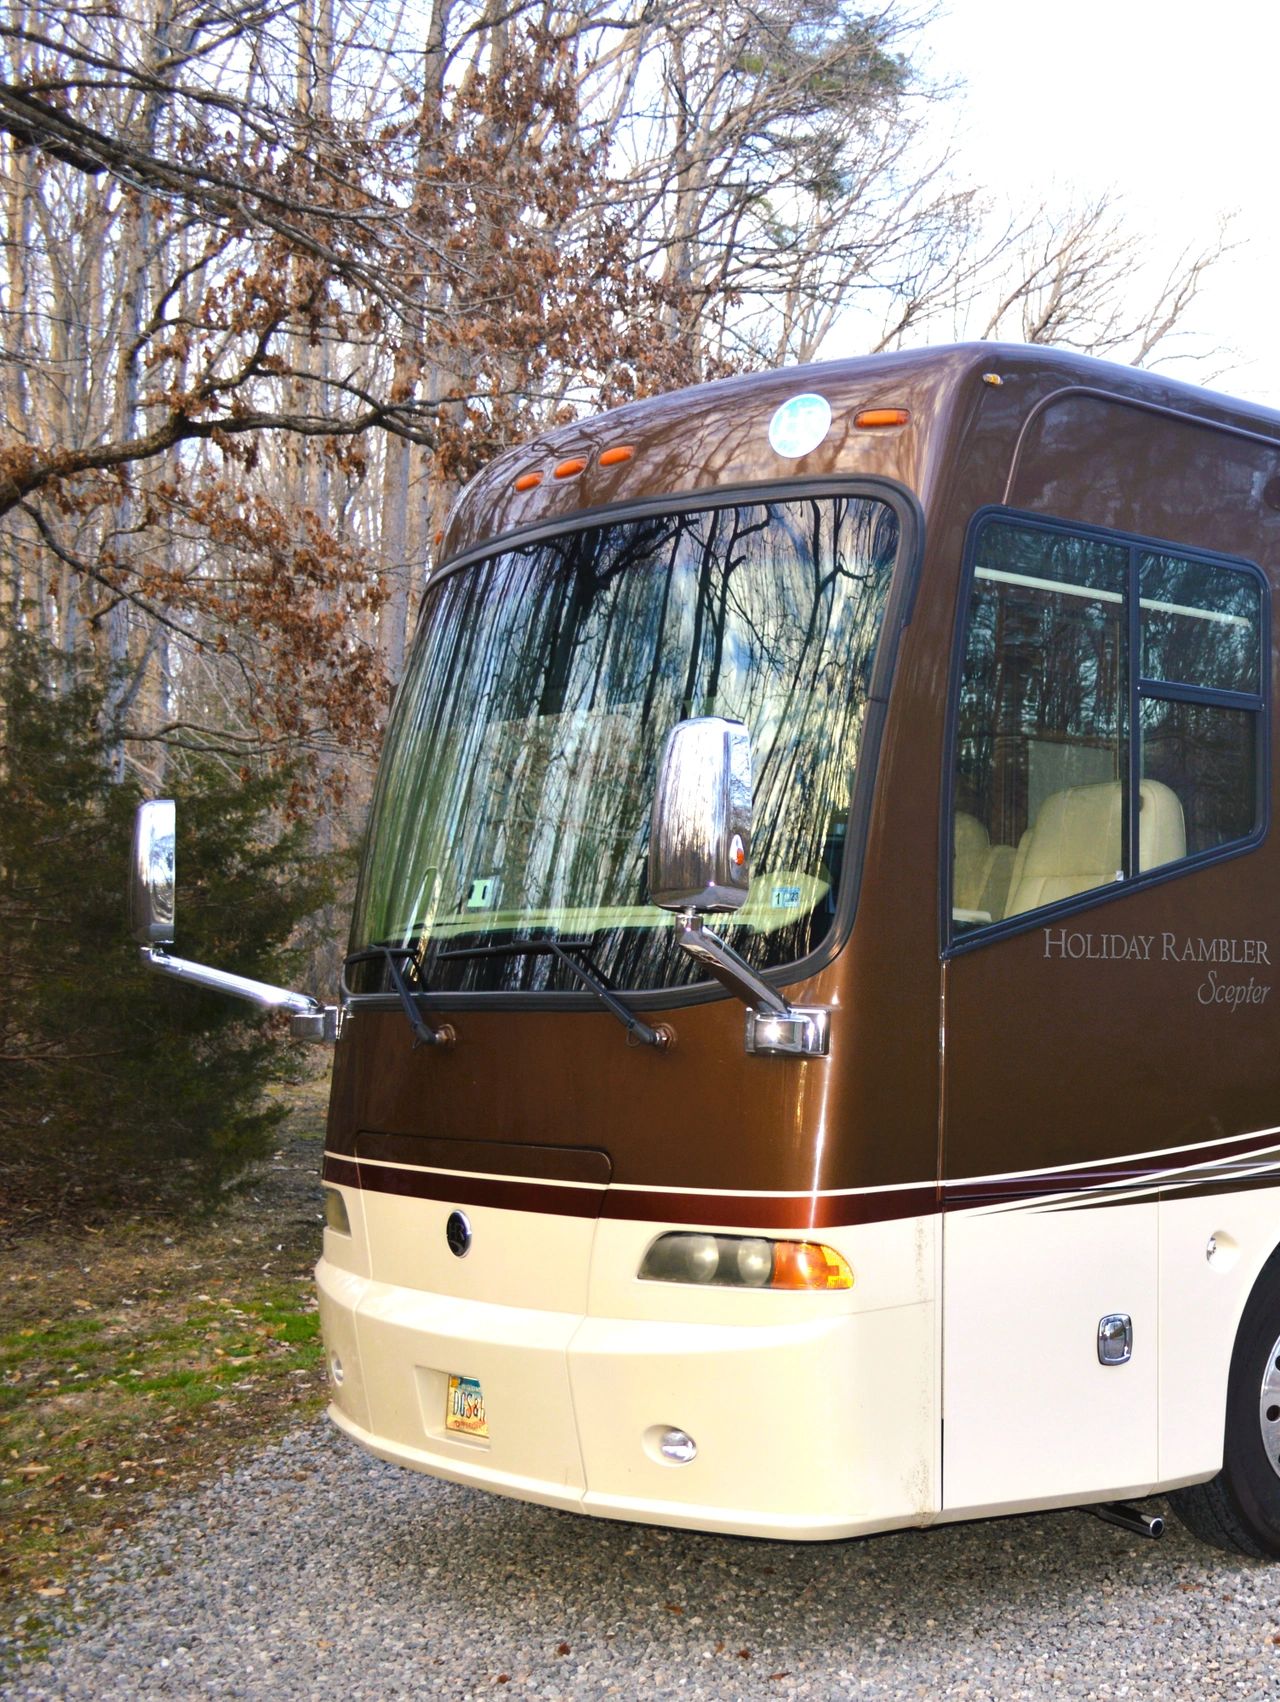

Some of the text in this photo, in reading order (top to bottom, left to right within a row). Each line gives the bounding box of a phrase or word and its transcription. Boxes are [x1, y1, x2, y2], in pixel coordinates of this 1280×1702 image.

[1043, 928, 1272, 966] HOLIDAY RAMBLER
[1197, 970, 1271, 1013] Scepter
